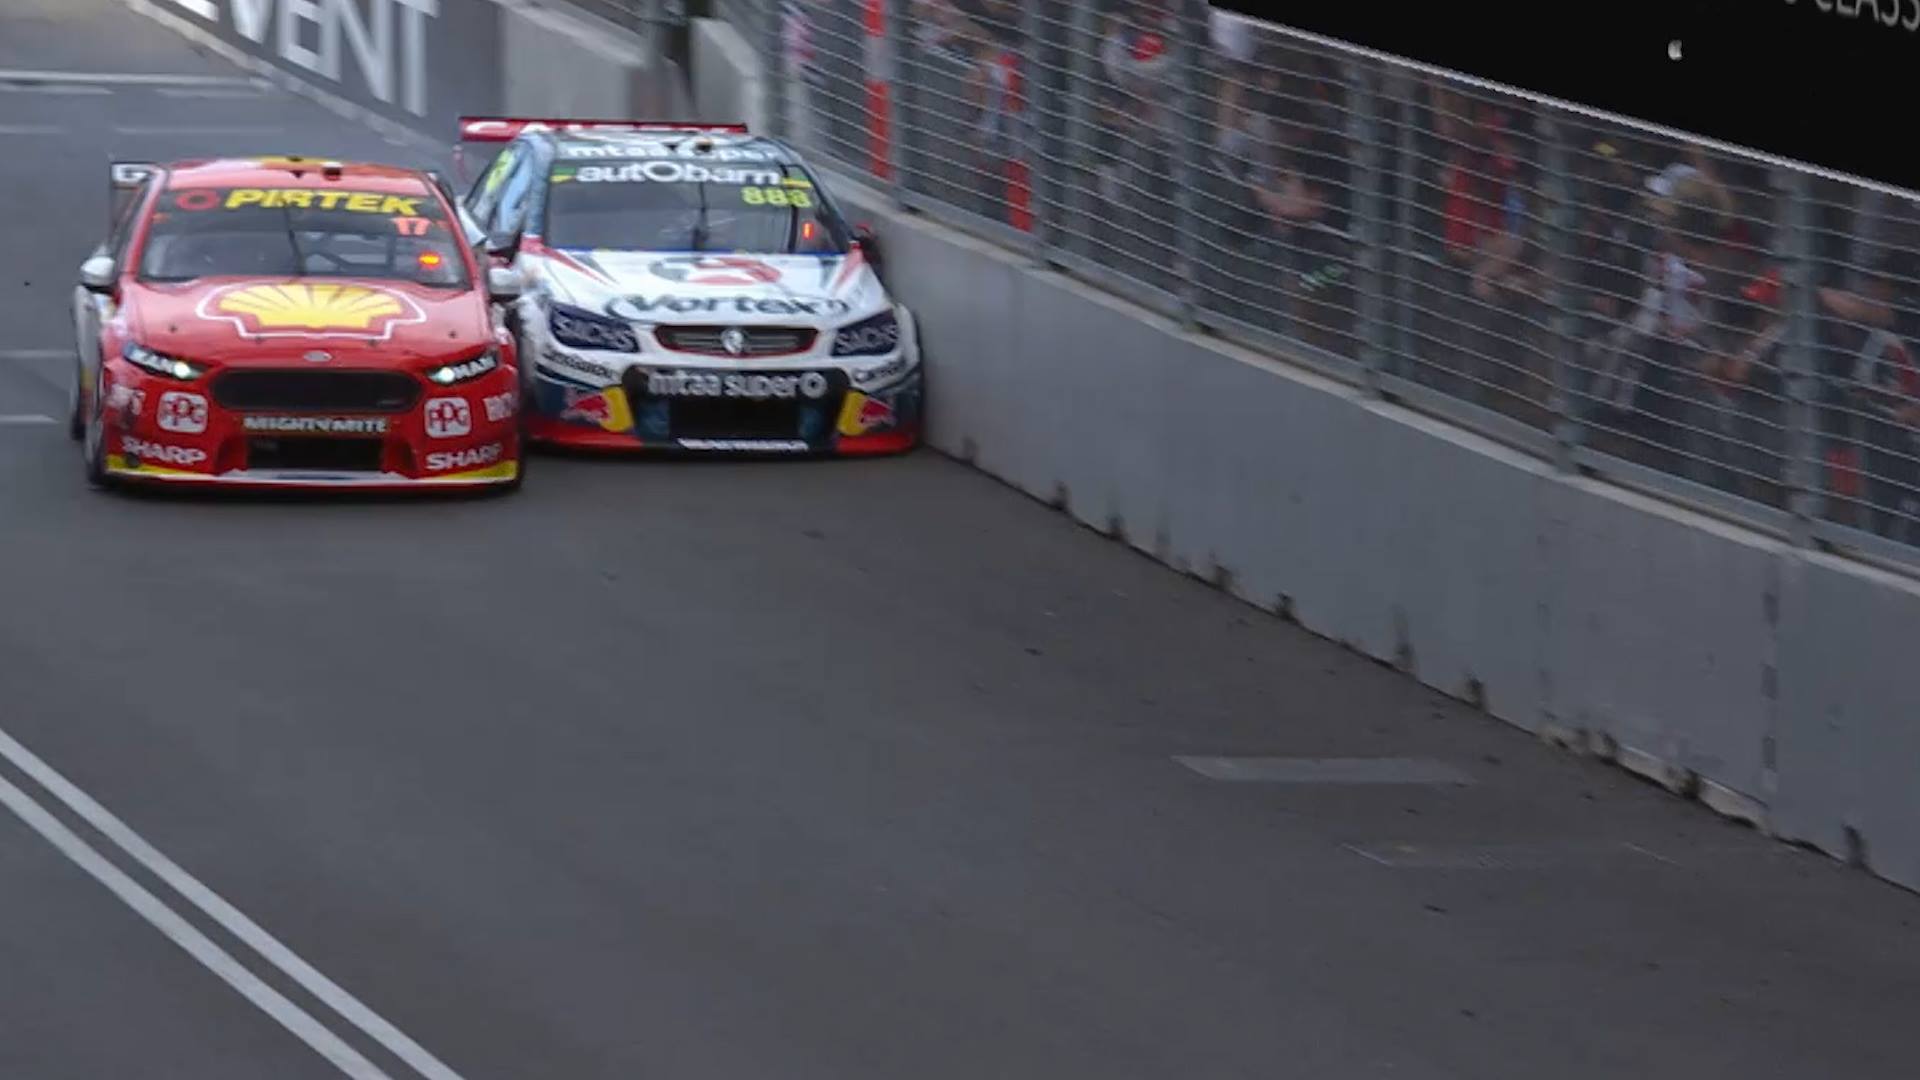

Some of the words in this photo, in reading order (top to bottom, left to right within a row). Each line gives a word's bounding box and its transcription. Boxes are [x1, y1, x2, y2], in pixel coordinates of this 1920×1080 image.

[225, 188, 424, 216] PIRTEK
[741, 187, 810, 208] 888
[391, 217, 432, 236] 17
[647, 370, 722, 397] mtaa
[723, 373, 799, 398] super
[121, 435, 208, 465] SHARP
